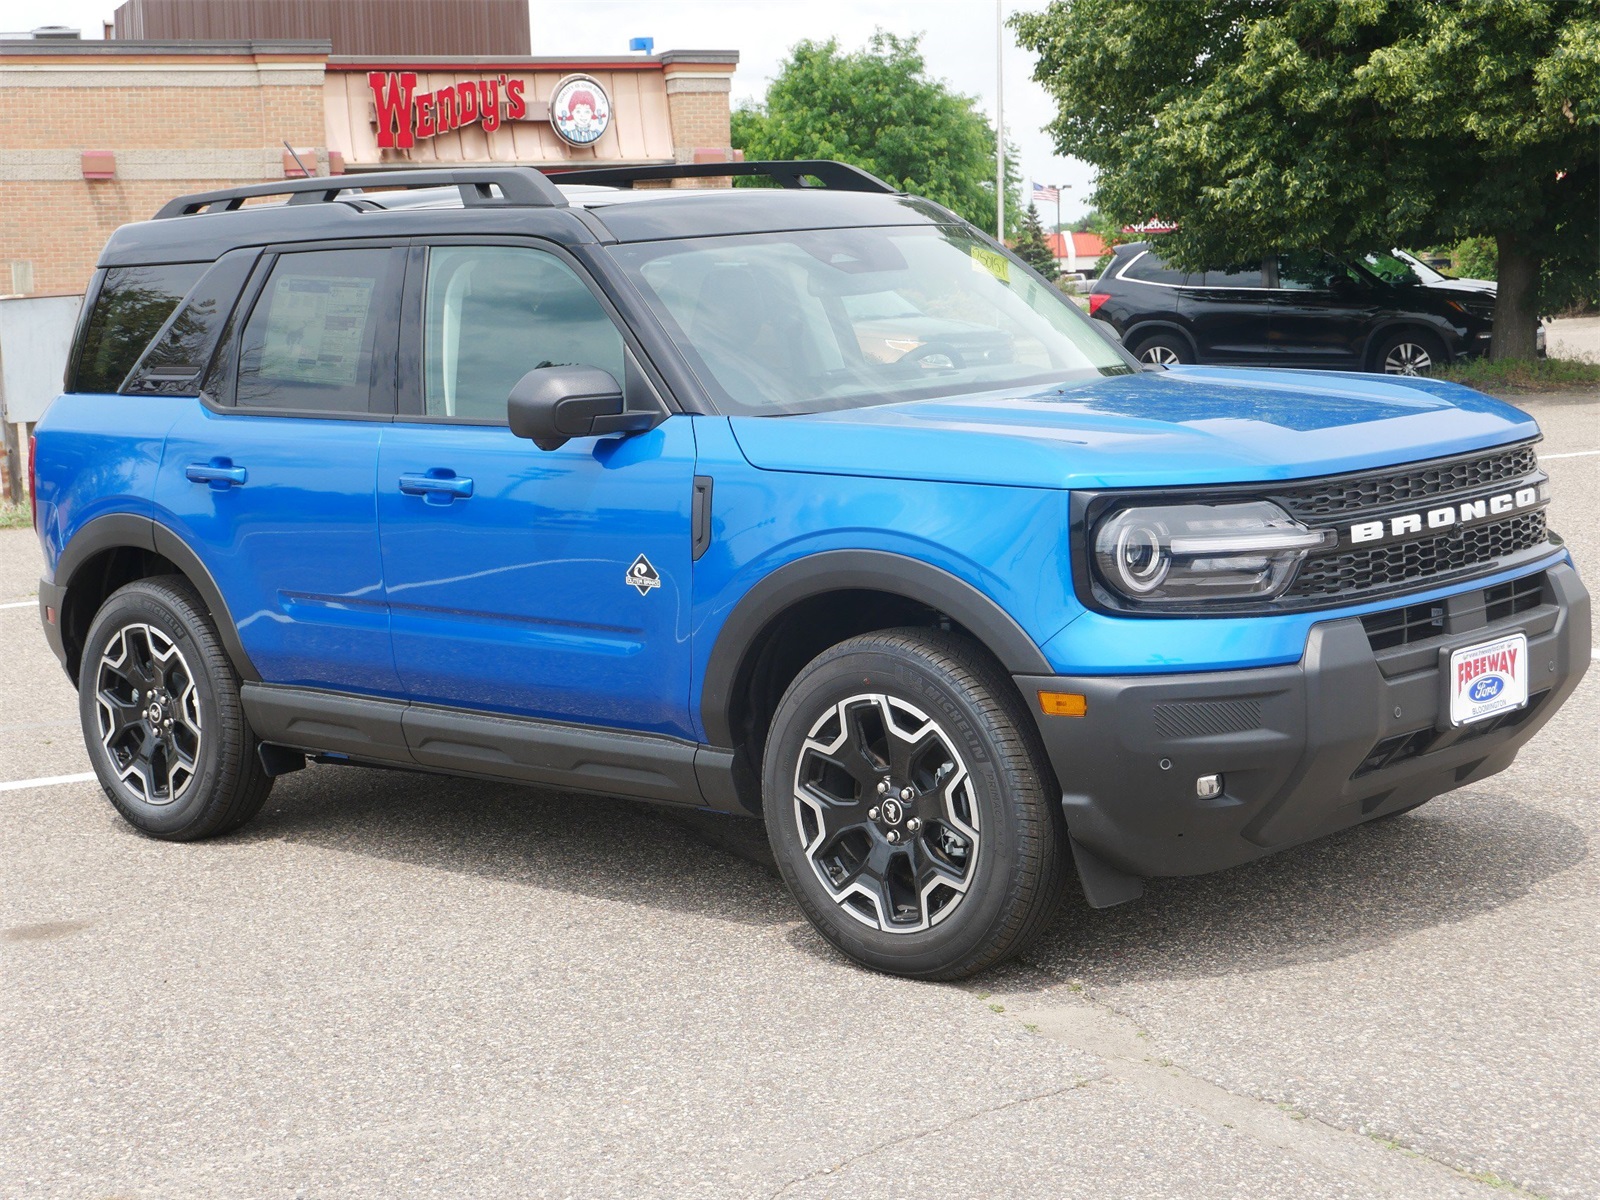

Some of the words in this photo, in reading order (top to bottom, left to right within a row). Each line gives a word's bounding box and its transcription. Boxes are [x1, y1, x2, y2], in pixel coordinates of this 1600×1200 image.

[1350, 487, 1536, 544] BRONCO
[1457, 648, 1518, 699] FREEWAY
[1475, 679, 1498, 699] Ford
[924, 685, 987, 760] MICHELIN
[1471, 699, 1507, 715] BLOOMINGTON
